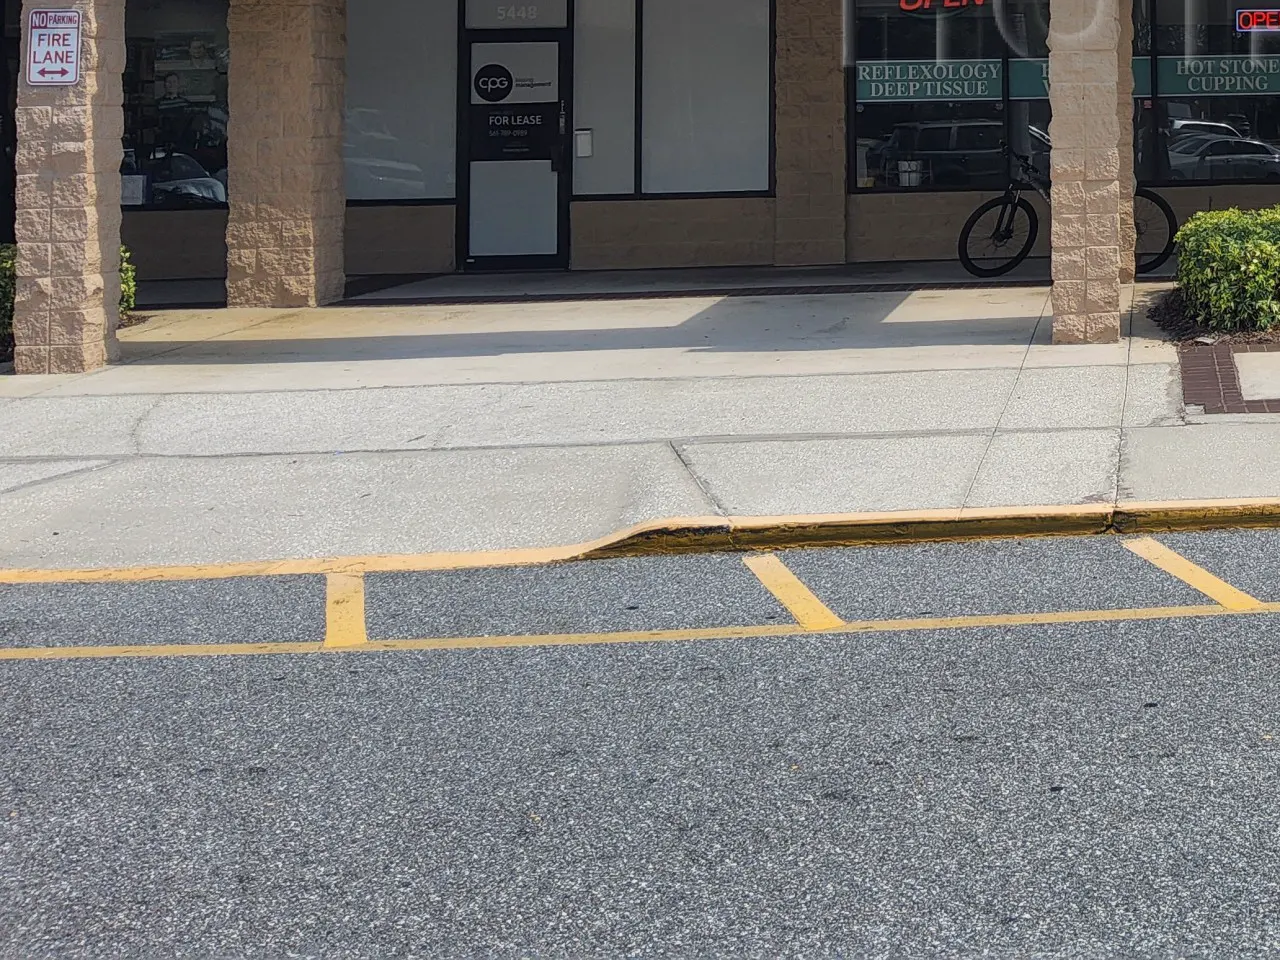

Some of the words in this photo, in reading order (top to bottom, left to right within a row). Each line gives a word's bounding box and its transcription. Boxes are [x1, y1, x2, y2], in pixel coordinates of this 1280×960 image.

[32, 12, 47, 27] NO
[48, 13, 78, 25] PARKING
[497, 5, 538, 20] 5448
[37, 33, 71, 47] FIRE
[32, 50, 74, 64] LANE
[858, 63, 1001, 81] REFLEXOLOGY
[1177, 60, 1215, 76] HOT
[1220, 59, 1279, 74] STONE
[870, 82, 919, 97] DEEP
[924, 80, 988, 96] TISSUE
[1187, 75, 1268, 92] CUPPING
[489, 116, 510, 126] FOR
[511, 115, 543, 125] LEASE
